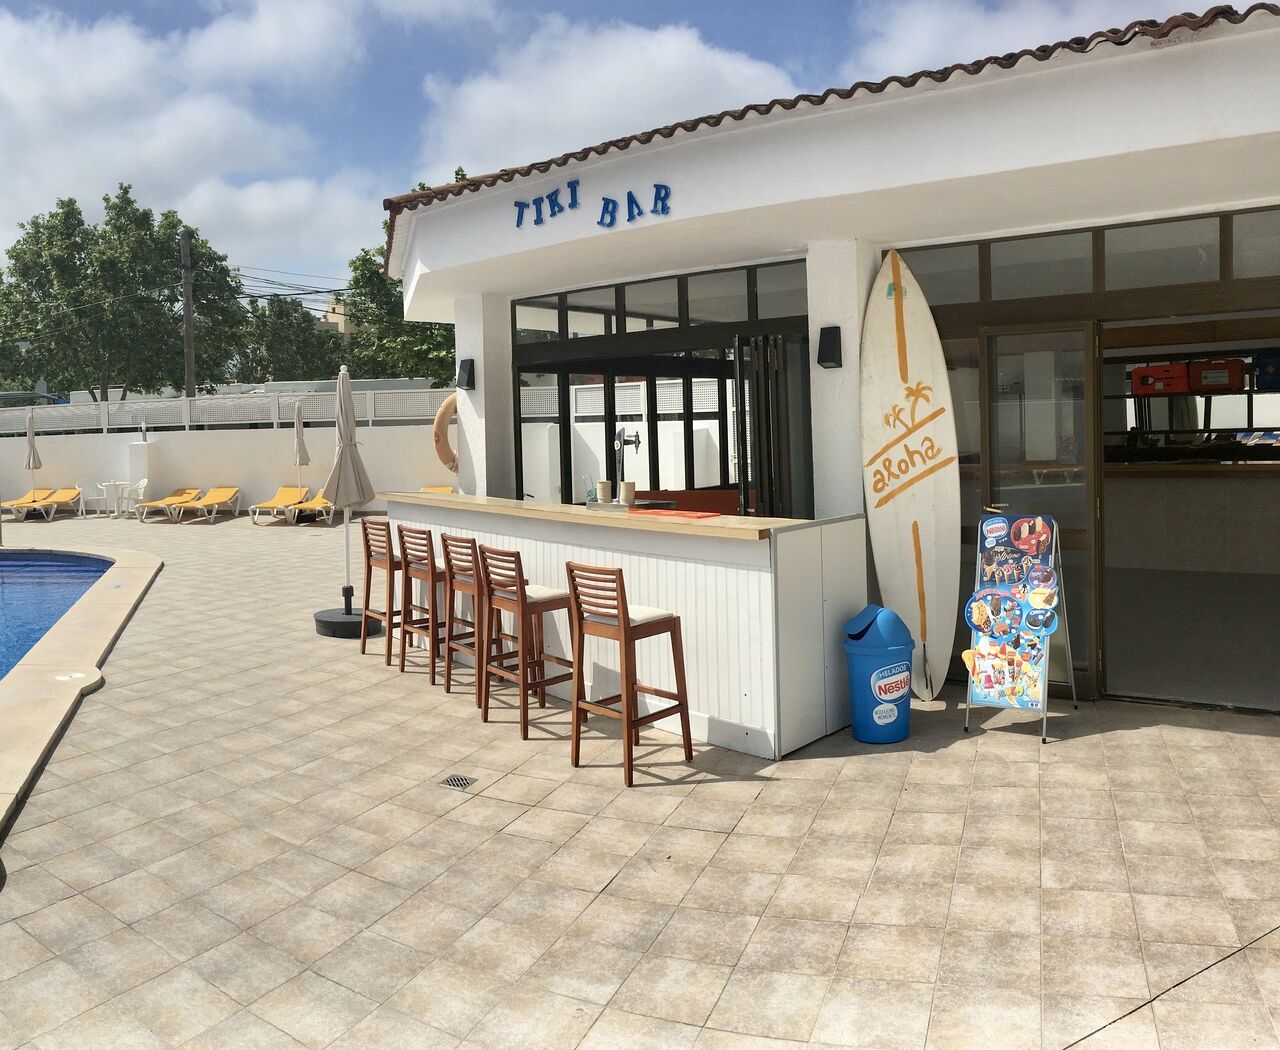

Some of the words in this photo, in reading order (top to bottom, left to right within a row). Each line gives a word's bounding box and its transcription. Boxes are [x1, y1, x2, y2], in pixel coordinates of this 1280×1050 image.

[513, 178, 580, 228] TIKI
[596, 183, 671, 228] BAR
[872, 435, 943, 493] aloha
[877, 674, 910, 696] Nestlé
[879, 664, 907, 678] HELADOS
